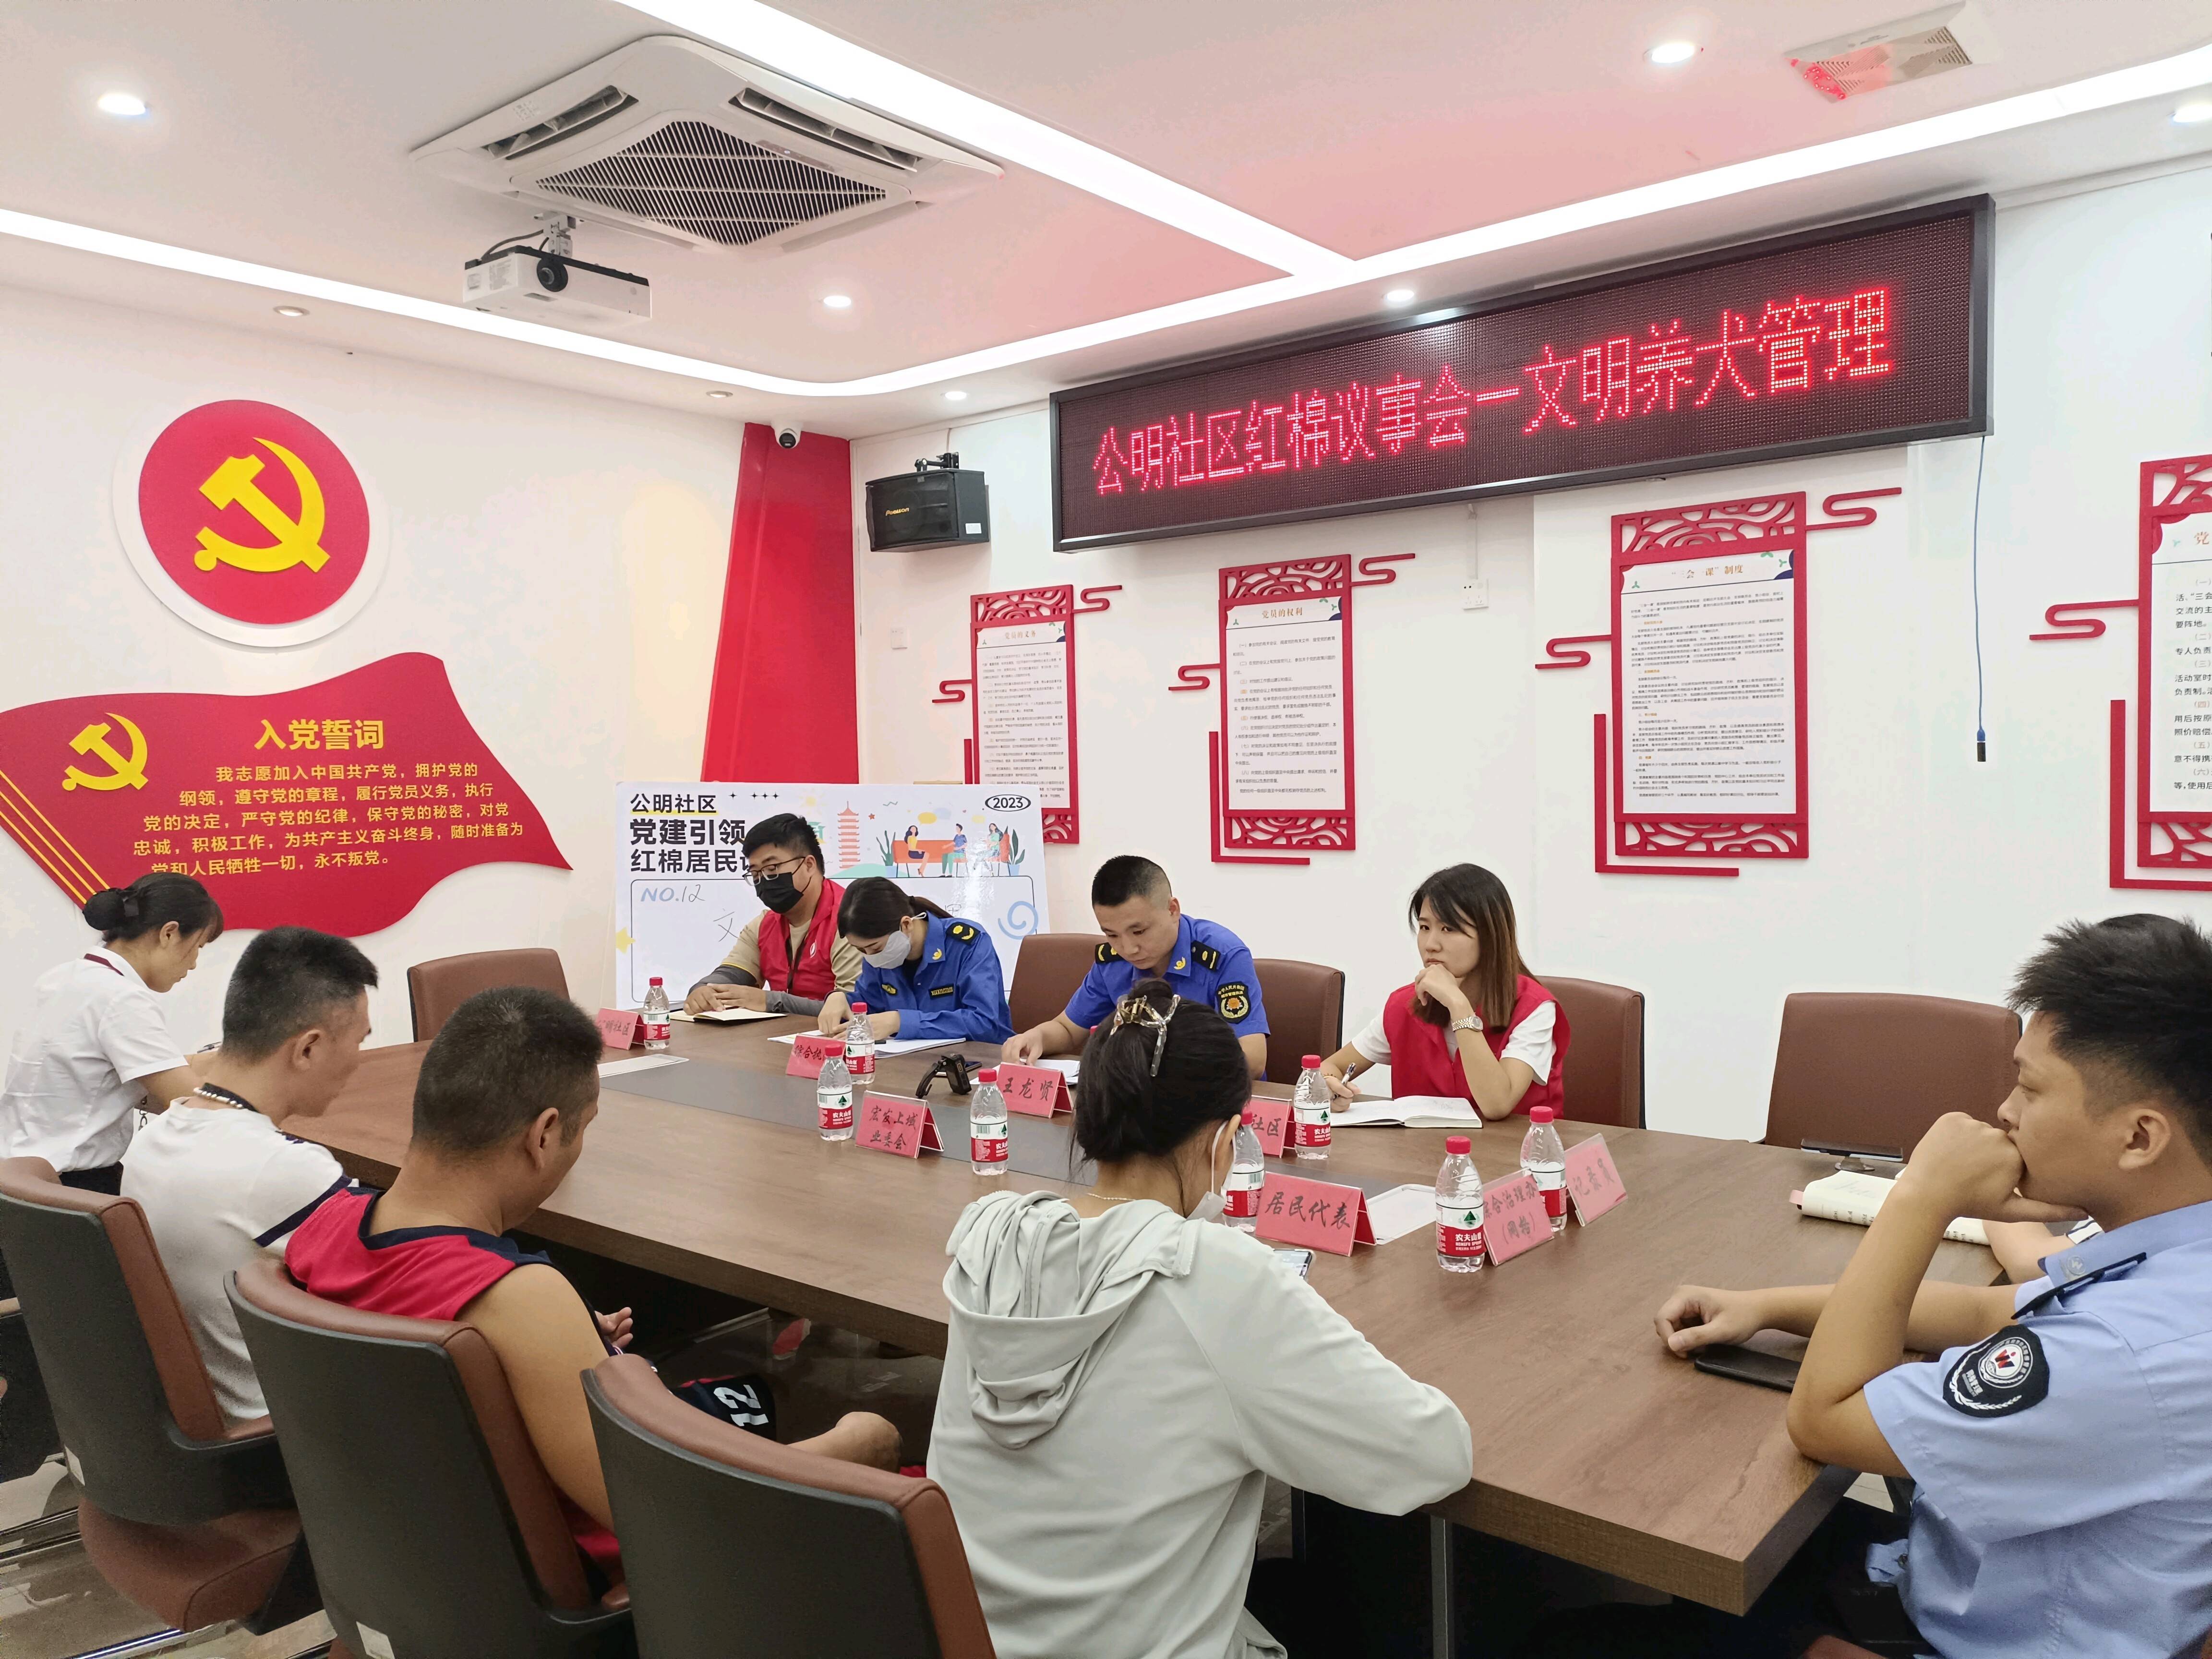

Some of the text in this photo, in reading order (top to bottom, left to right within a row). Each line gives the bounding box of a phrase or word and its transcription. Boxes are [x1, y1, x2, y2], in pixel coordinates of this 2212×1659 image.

[1261, 607, 1303, 619] 党员的权利
[254, 719, 385, 751] 入党誓词
[630, 793, 717, 814] 公明社区
[993, 797, 1023, 809] 2023
[630, 818, 745, 845] 党建引领
[794, 1045, 826, 1061] 综合执
[1264, 1191, 1351, 1230] 居民代表
